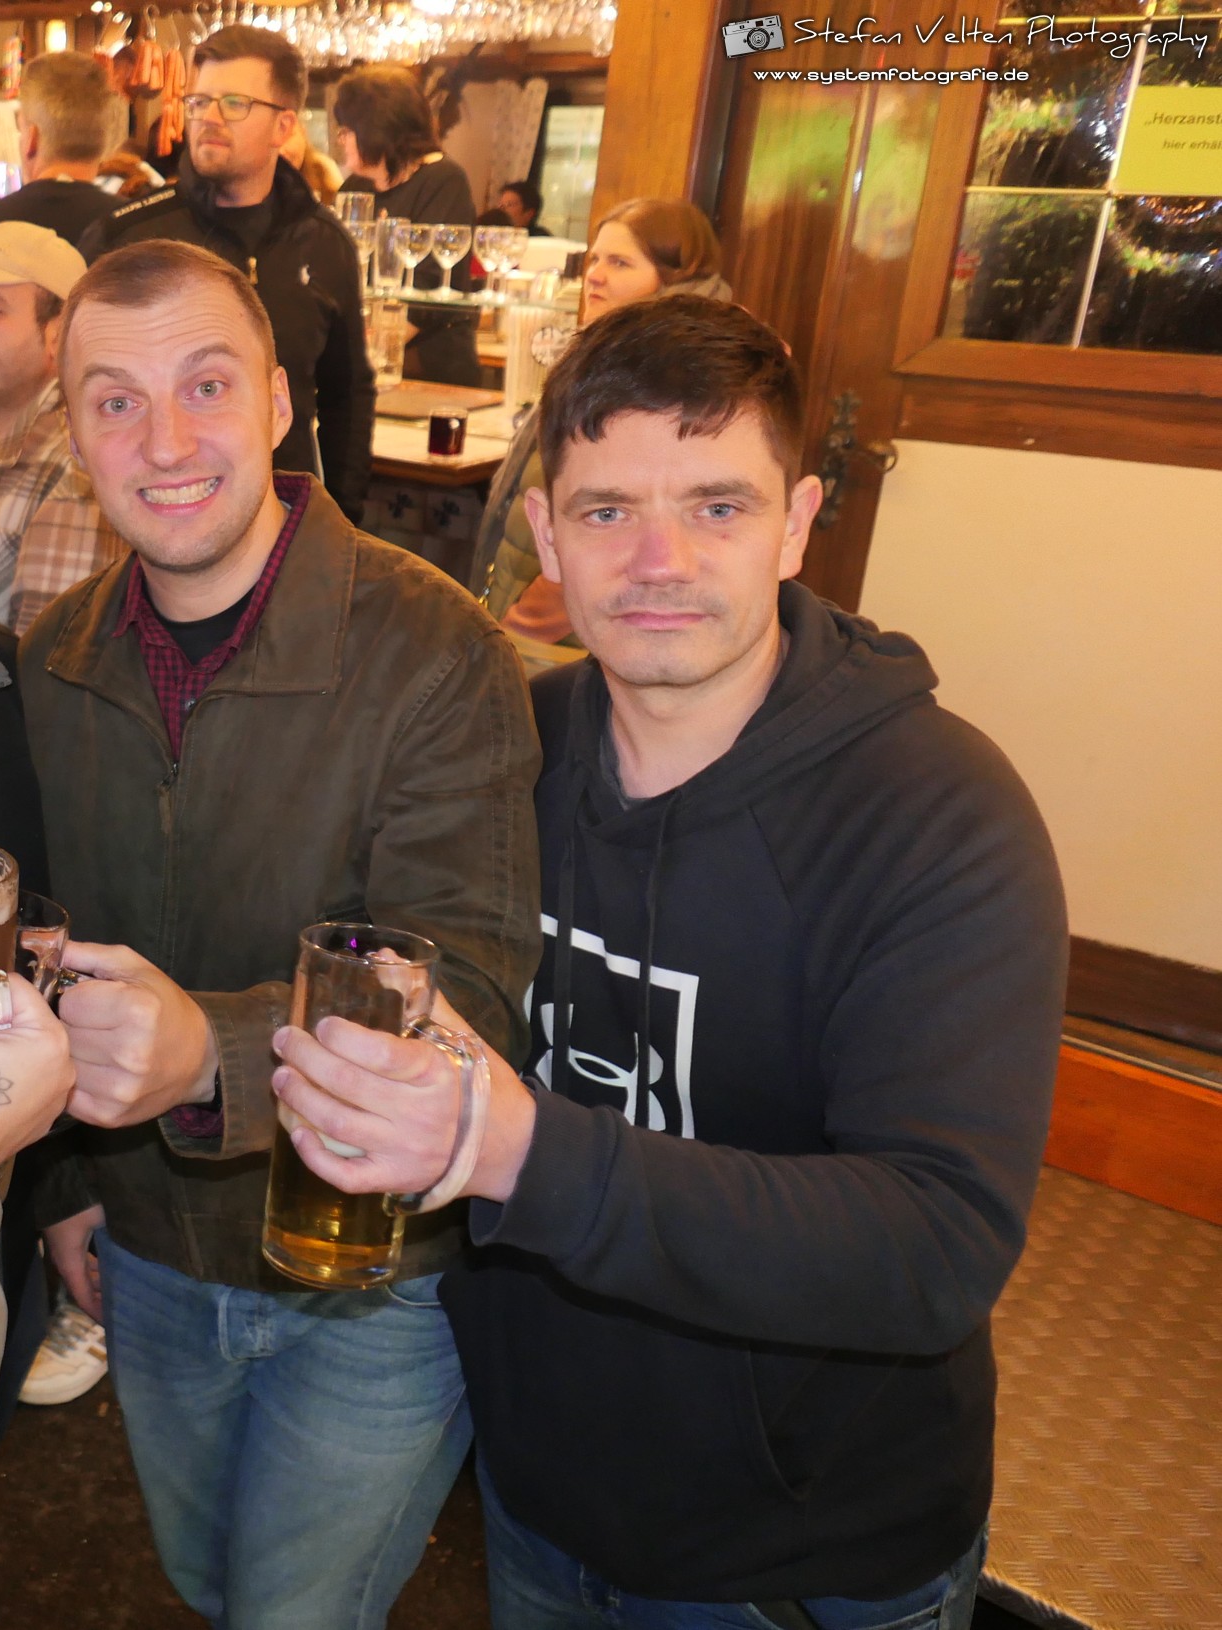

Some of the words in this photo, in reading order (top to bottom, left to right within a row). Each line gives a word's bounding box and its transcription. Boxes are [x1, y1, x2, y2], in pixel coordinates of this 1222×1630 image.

[1144, 112, 1222, 126] „Herzanst
[1162, 140, 1186, 149] hier
[1189, 140, 1222, 150] erhäl
